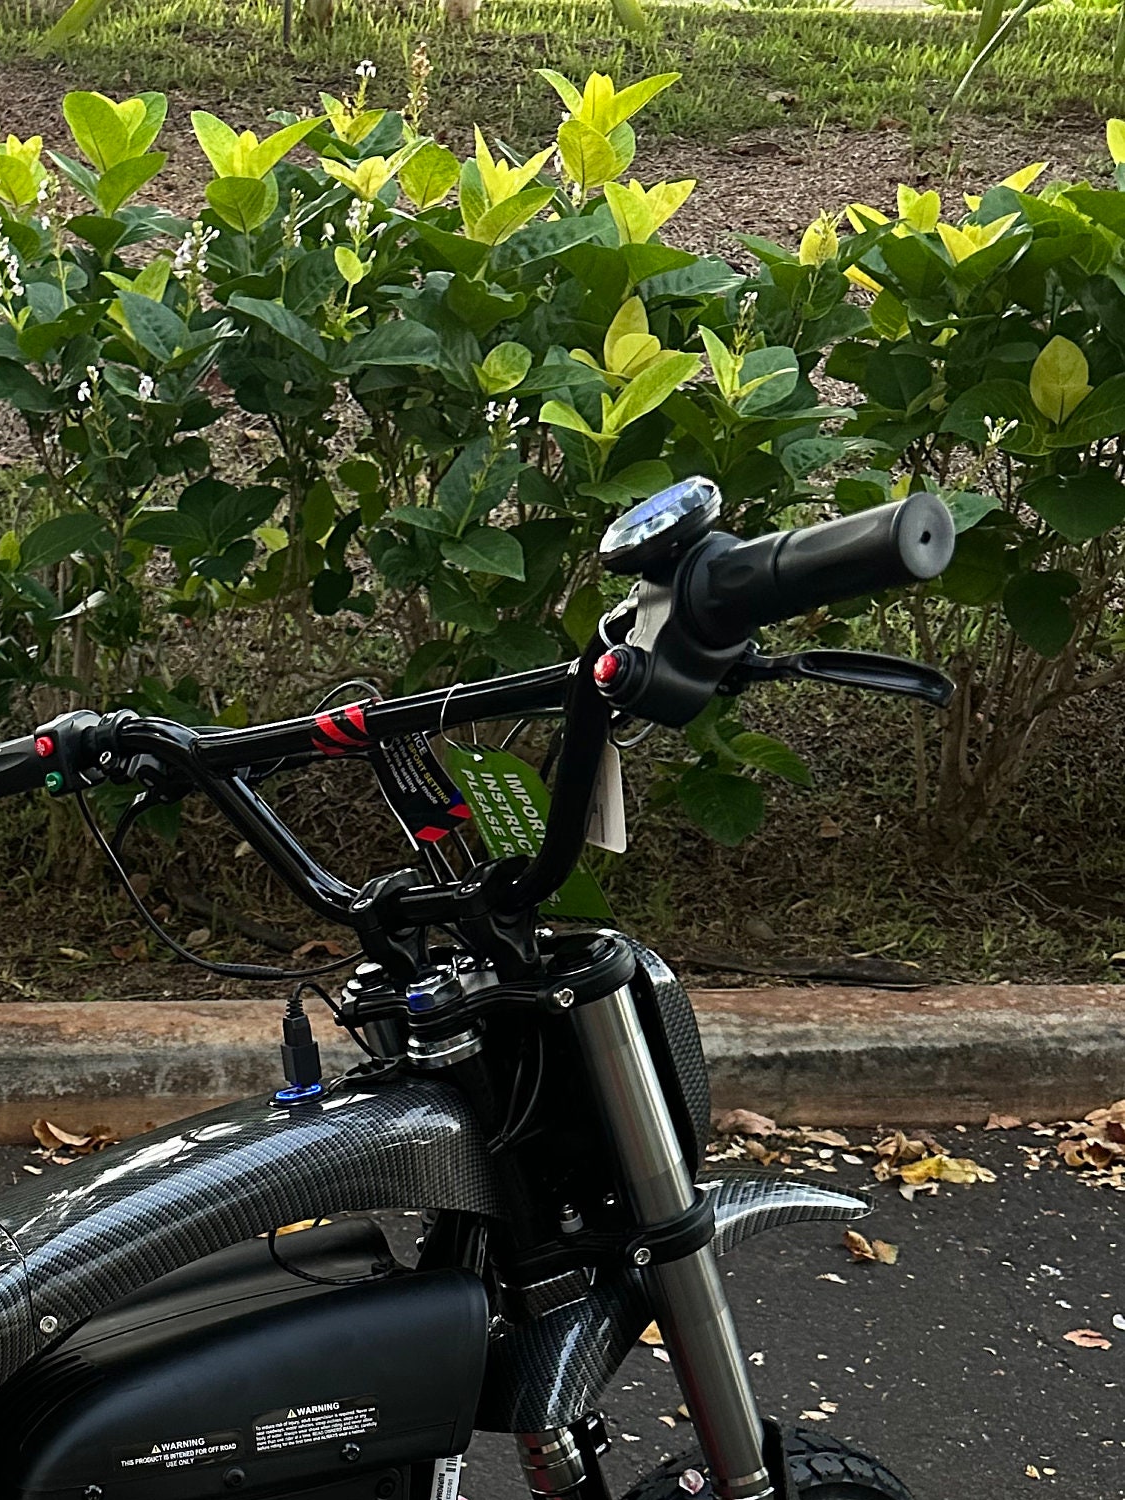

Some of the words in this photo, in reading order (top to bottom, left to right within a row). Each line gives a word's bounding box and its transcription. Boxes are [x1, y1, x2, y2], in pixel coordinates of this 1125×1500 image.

[400, 767, 417, 793] setting
[406, 758, 424, 786] Normal
[421, 785, 438, 804] mode
[408, 743, 426, 771] SPORT
[424, 772, 450, 804] SETTING
[461, 769, 507, 837] PLEASE
[503, 773, 547, 845] IMPORT
[297, 1402, 339, 1416] WARNING
[135, 1455, 162, 1465] PRODUCT
[195, 1448, 207, 1456] FOR
[220, 1443, 236, 1451] ROAD
[161, 1438, 205, 1451] WARNING
[179, 1458, 194, 1466] ONLY
